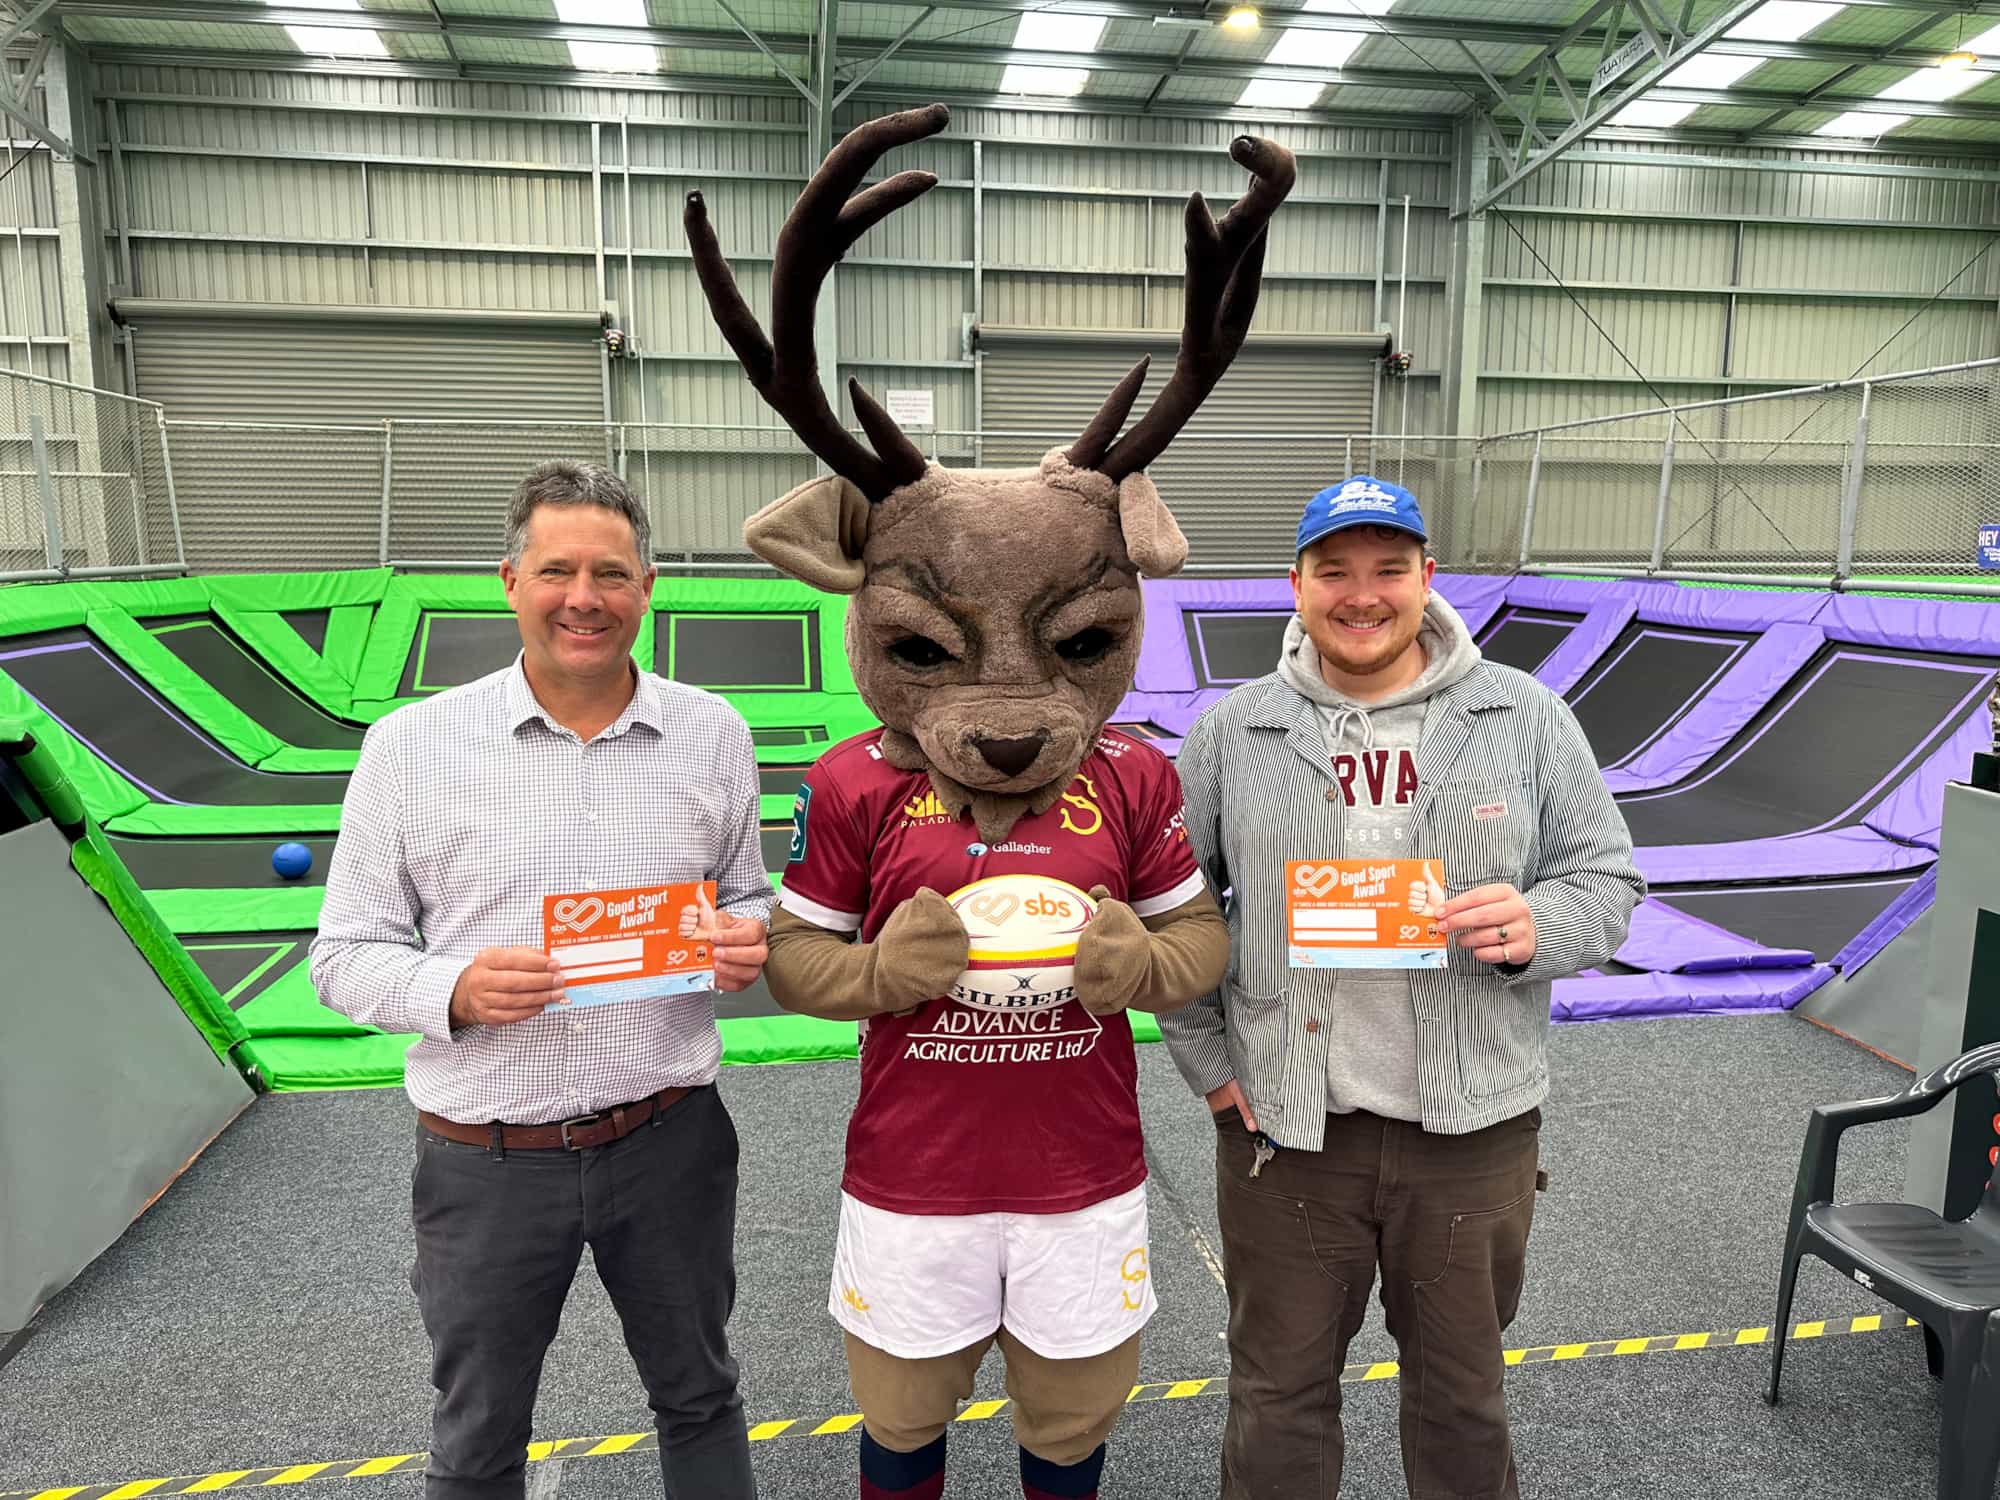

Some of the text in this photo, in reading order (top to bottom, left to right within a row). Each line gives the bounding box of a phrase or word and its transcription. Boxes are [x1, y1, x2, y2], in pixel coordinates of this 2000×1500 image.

[1597, 37, 1644, 78] TUATARA
[1978, 530, 1999, 546] HEY
[1330, 747, 1419, 809] RVA
[901, 815, 952, 828] PALADI
[1345, 828, 1381, 841] ESS
[992, 841, 1052, 854] Gallagher
[1341, 863, 1396, 886] Good Sport
[1353, 880, 1385, 899] Award
[607, 890, 668, 918] Good Sport
[1024, 891, 1072, 918] sbs
[619, 907, 655, 930] Award
[952, 984, 1075, 1008] GILBER
[932, 1008, 1064, 1034] ADVANCE
[904, 1037, 1084, 1063] AGRICULTURE Ltd
